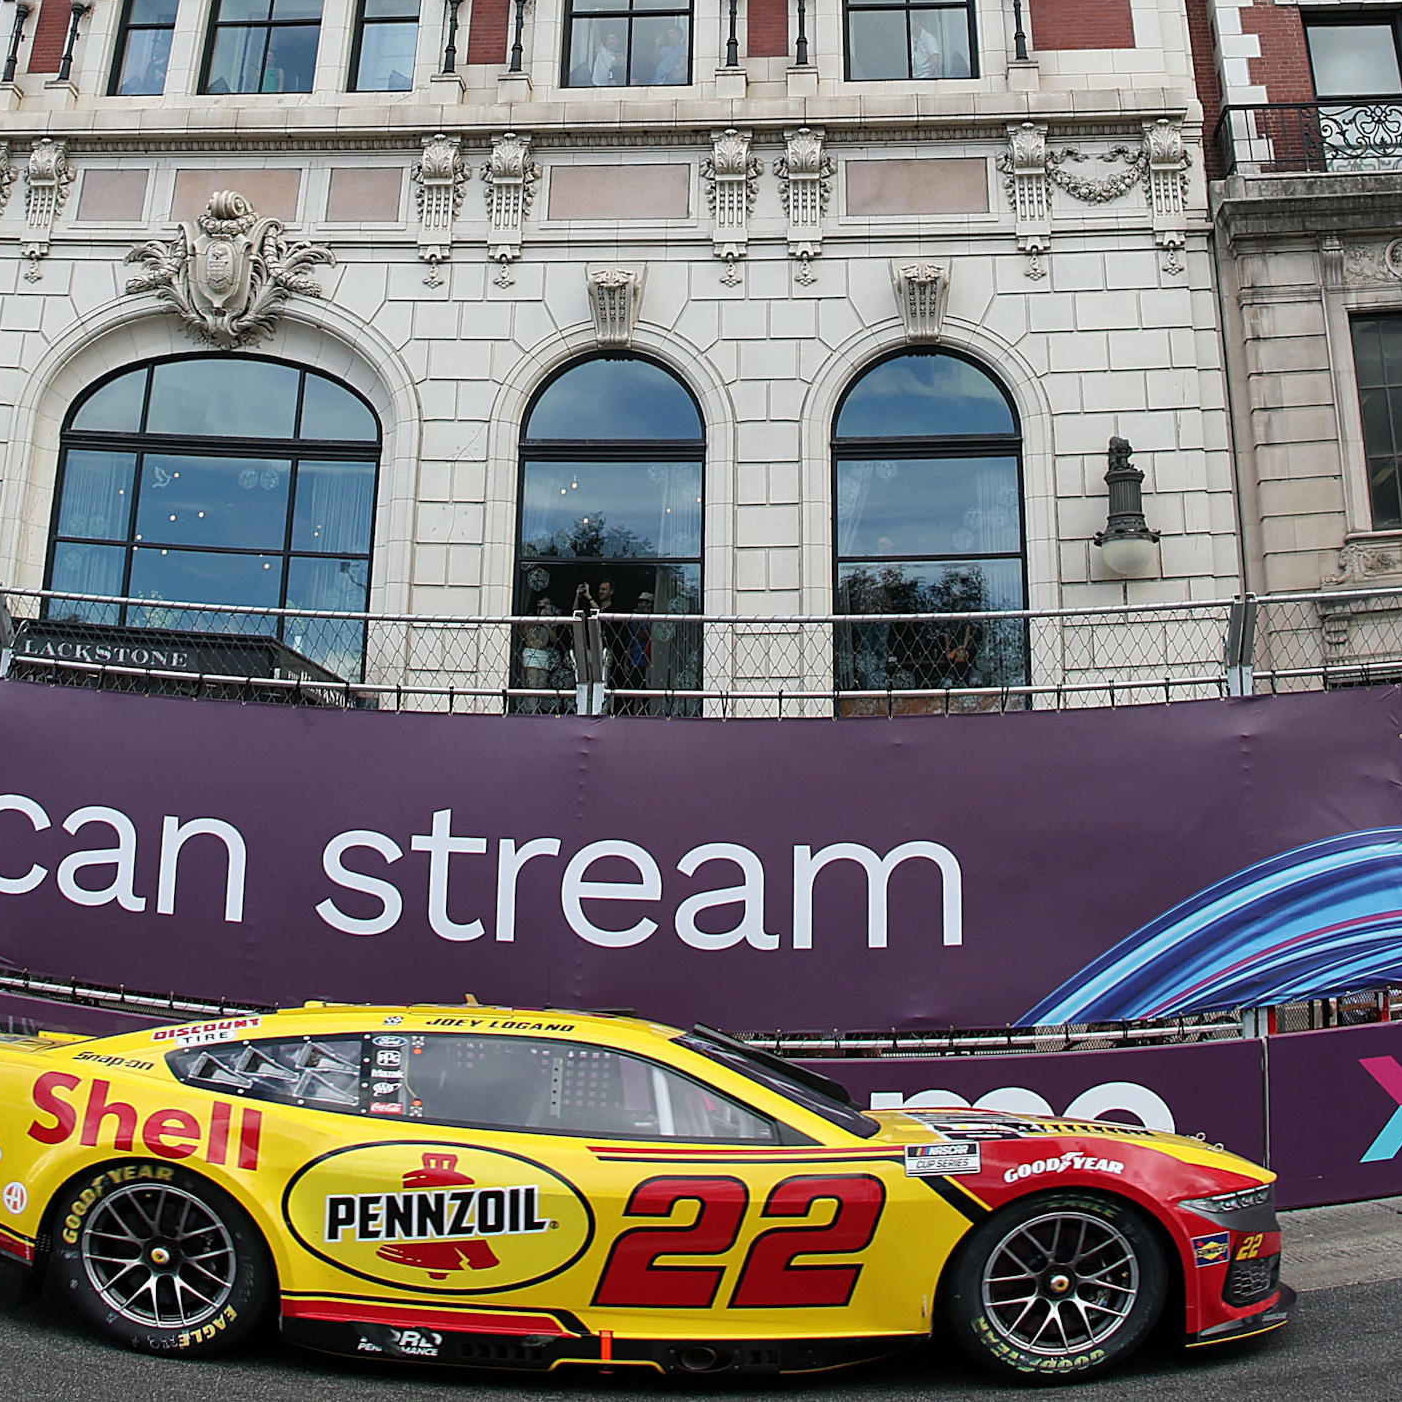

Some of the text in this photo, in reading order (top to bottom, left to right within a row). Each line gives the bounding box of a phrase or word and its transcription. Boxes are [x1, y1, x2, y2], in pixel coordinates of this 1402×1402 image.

[23, 639, 188, 669] LACKSTONE
[315, 808, 963, 951] stream
[153, 1017, 262, 1041] DISCOUNT
[183, 1030, 231, 1044] TIRE
[425, 1018, 575, 1033] JOEY LOGANO
[72, 1051, 155, 1072] Snap-on
[26, 1070, 263, 1172] Shell
[916, 1157, 970, 1169] CUP SERIES
[927, 1144, 969, 1157] NASCAR
[1003, 1151, 1125, 1184] GOODYEAR
[324, 1184, 551, 1243] PENNZOIL
[597, 1173, 888, 1308] 22
[1235, 1233, 1264, 1261] 22
[177, 1304, 238, 1348] EAGLE
